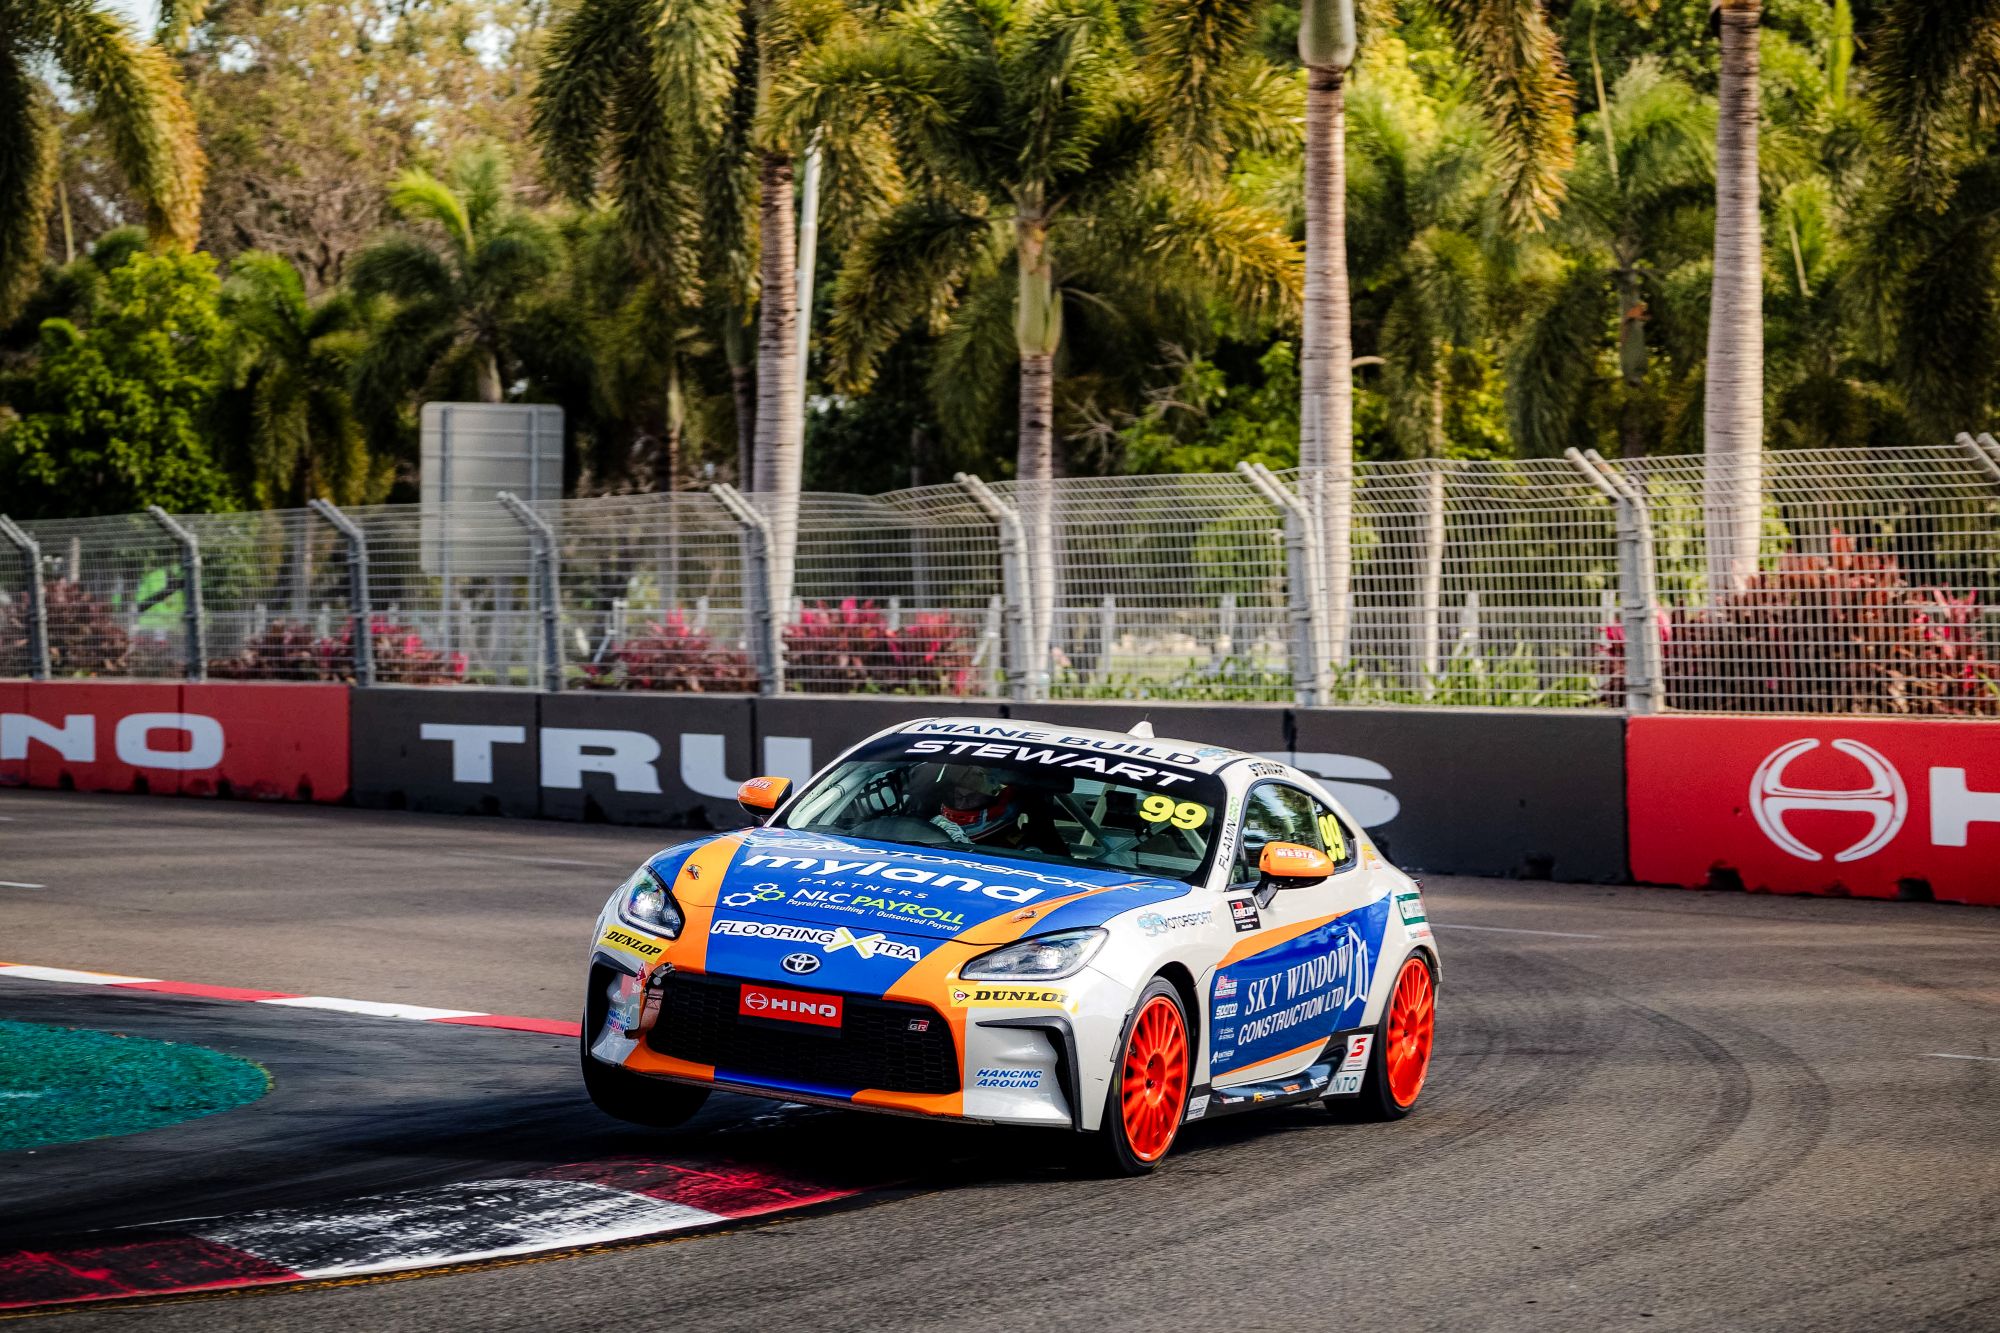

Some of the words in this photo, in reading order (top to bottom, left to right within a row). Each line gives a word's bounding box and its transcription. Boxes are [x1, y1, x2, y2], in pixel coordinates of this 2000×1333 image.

[918, 723, 1051, 744] MANE
[1057, 735, 1200, 765] BUILD
[905, 740, 1196, 787] STEWART
[1139, 796, 1207, 830] 99
[1318, 813, 1346, 862] 99
[740, 854, 1045, 904] myland
[797, 877, 929, 899] PARTNERS
[786, 898, 819, 908] Payroll
[819, 902, 866, 915] Consulting
[792, 888, 852, 903] NLC
[850, 895, 965, 925] PAYROLL
[876, 910, 928, 925] Outsourced
[926, 920, 961, 932] Payroll
[605, 931, 663, 956] DUNLOP
[1245, 973, 1283, 1016] SKY
[1287, 944, 1351, 1000] WINDOW
[771, 998, 837, 1017] HINO
[1238, 993, 1326, 1046] CONSTRUCTION
[1324, 986, 1345, 1012] LTD
[908, 1022, 929, 1032] GR
[976, 1069, 1043, 1079] HANGING
[976, 1079, 1039, 1088] AROUND
